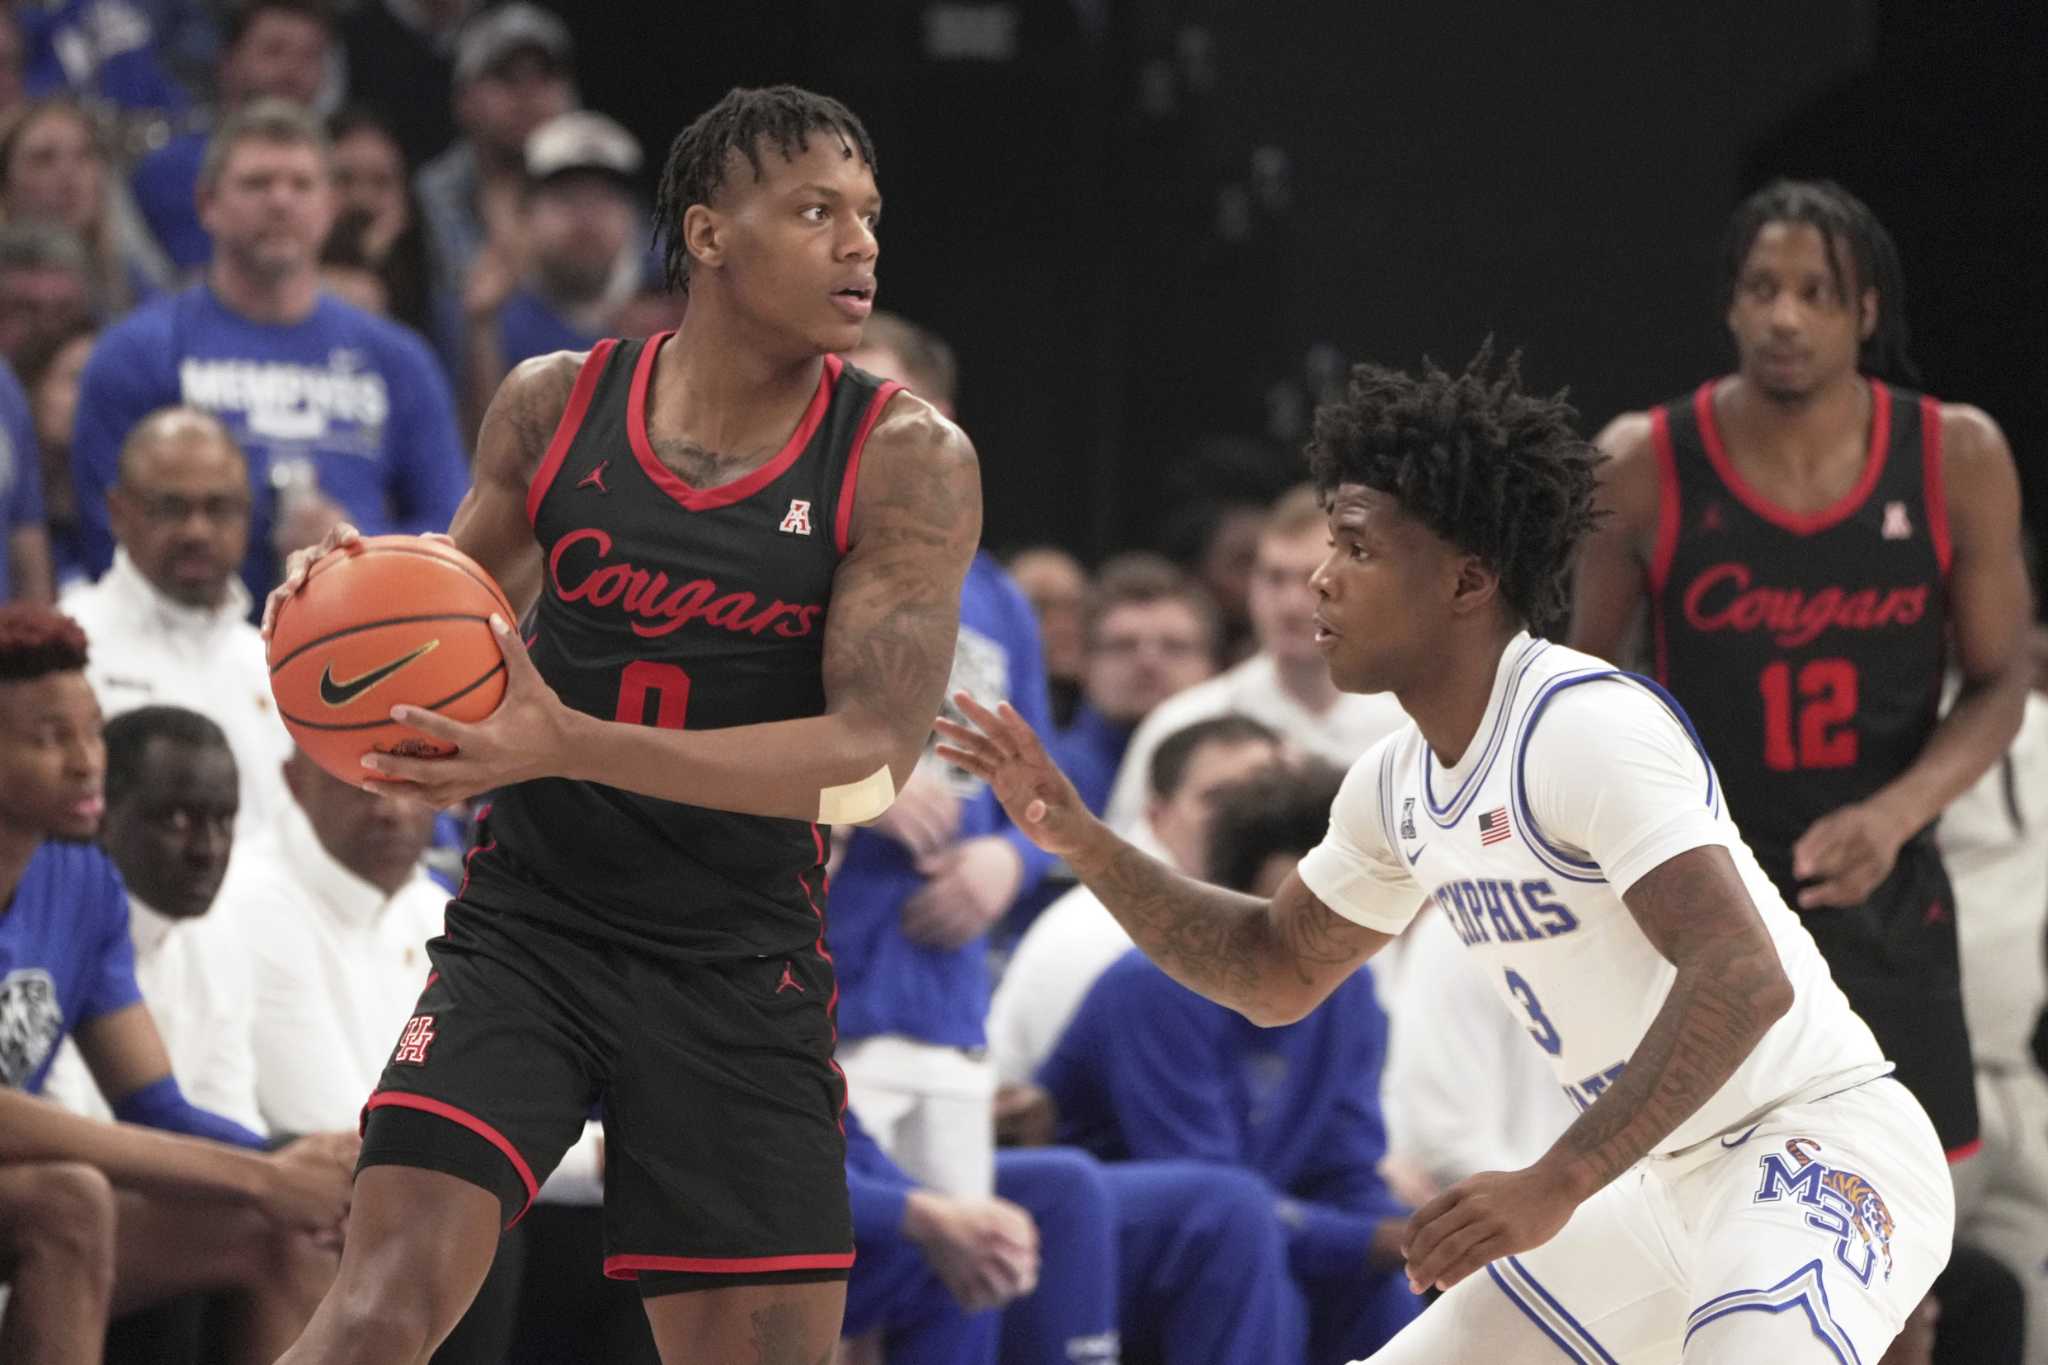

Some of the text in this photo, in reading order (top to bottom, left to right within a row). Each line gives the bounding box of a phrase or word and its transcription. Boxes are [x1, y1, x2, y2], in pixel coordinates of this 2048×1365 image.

[551, 528, 822, 637] Cougars
[1683, 562, 1929, 646] Cougars
[1760, 658, 1858, 771] 12
[1504, 966, 1562, 1057] 3
[1752, 1152, 1878, 1290] MSU
